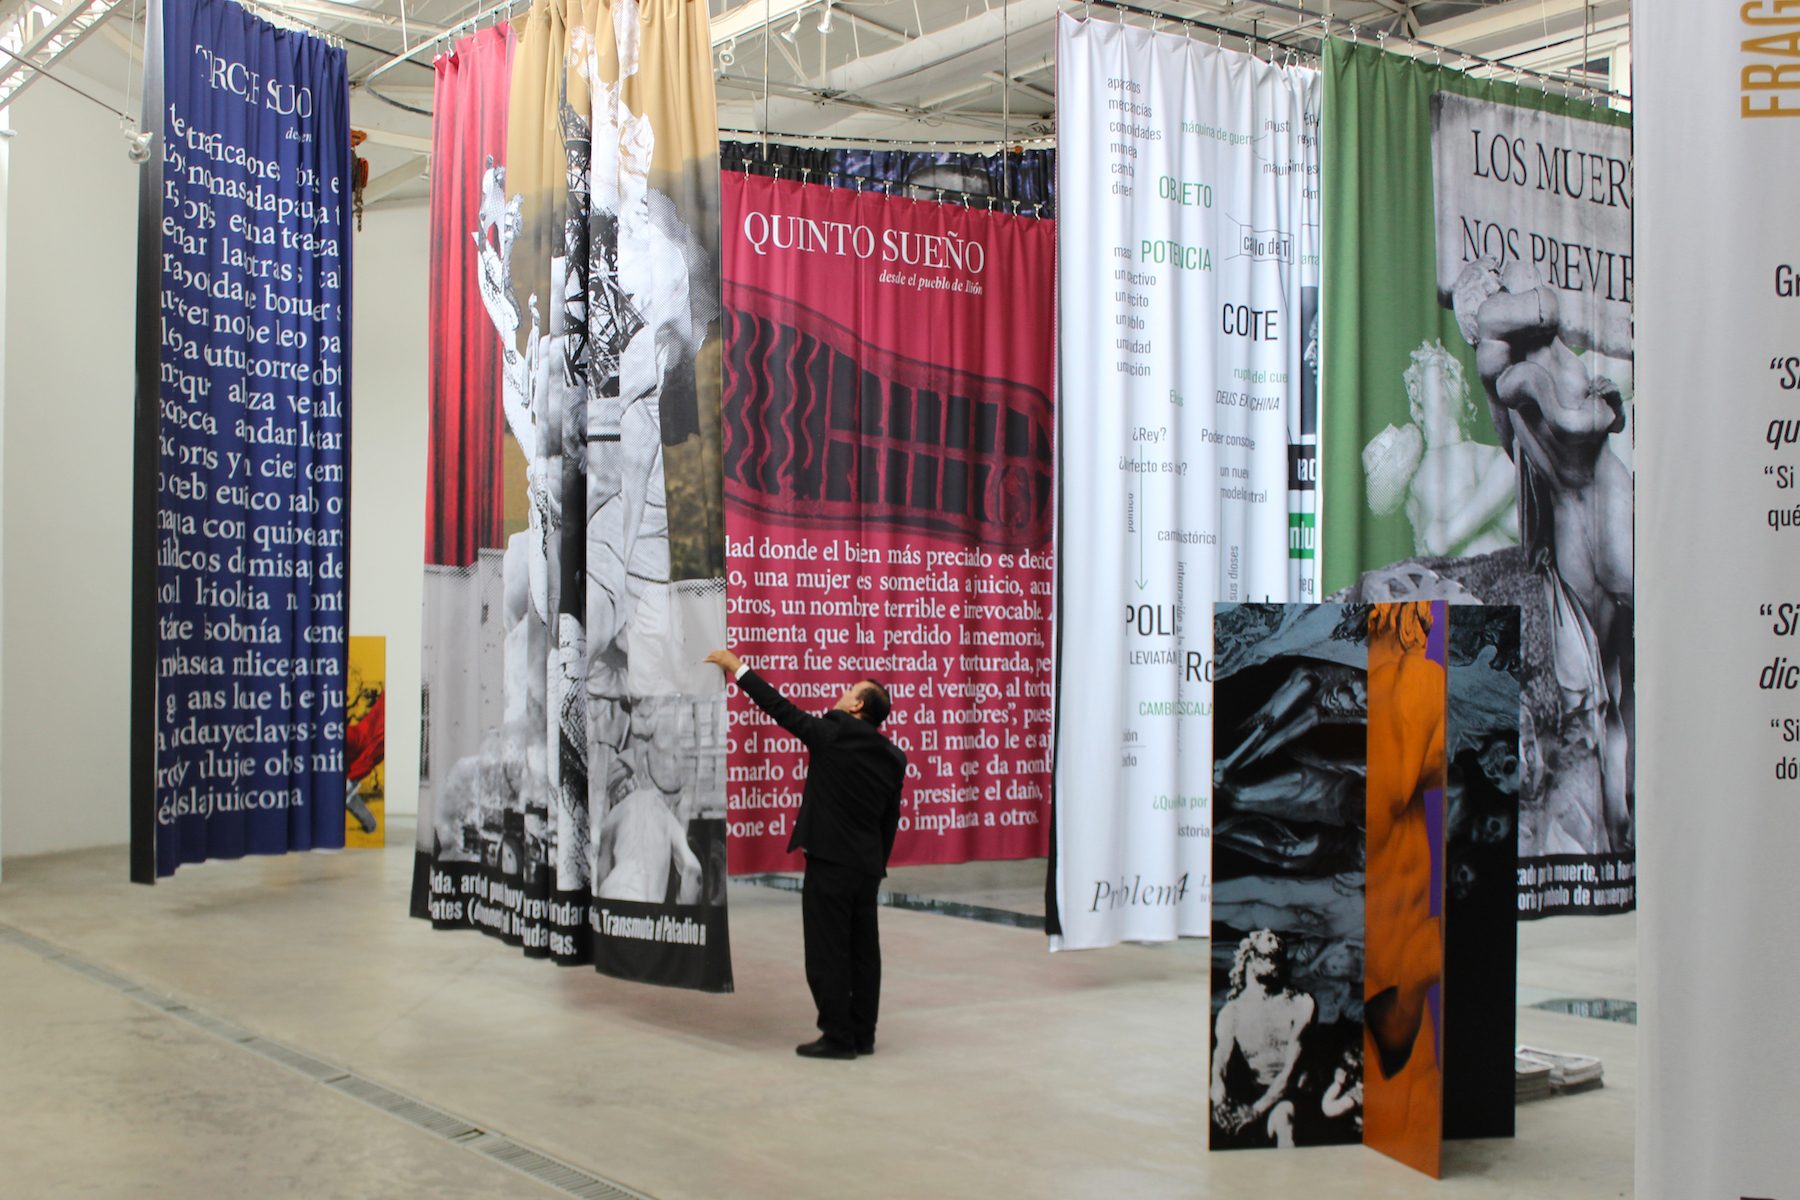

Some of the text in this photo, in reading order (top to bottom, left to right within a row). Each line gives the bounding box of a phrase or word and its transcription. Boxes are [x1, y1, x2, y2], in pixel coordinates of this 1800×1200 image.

[1217, 127, 1227, 141] de
[1471, 130, 1527, 187] LOS
[744, 211, 985, 274] QUINTO SUEÑO
[1460, 216, 1520, 267] NOS
[1141, 240, 1212, 272] POTENCIA
[879, 269, 906, 285] desde
[908, 273, 917, 287] el
[917, 276, 951, 291] pueblo
[951, 278, 963, 292] de
[1251, 370, 1266, 384] del
[1216, 390, 1238, 406] DEUS
[1132, 426, 1167, 444] ¿Rey?
[759, 537, 817, 560] donde
[823, 540, 838, 561] el
[845, 541, 881, 563] bien
[887, 545, 921, 565] más
[926, 547, 992, 571] preciado
[999, 554, 1014, 568] es
[754, 571, 788, 587] una
[796, 569, 851, 595] mujer
[857, 575, 872, 590] es
[880, 571, 959, 592] sometida
[965, 579, 971, 592] a
[973, 575, 1024, 599] juicio,
[727, 595, 1044, 620] otros, un nombre terrible e irrevocable.
[727, 623, 1044, 650] gumenta que ha perdido la memoria,
[739, 654, 798, 671] guerra
[804, 649, 832, 670] fue
[838, 650, 937, 672] secuestrada
[943, 656, 955, 678] y
[960, 651, 1033, 673] torturada,
[919, 677, 933, 697] el
[937, 677, 1002, 703] verdugo,
[1006, 677, 1020, 697] al
[914, 703, 935, 724] da
[745, 732, 757, 753] el
[921, 730, 938, 750] El
[945, 728, 999, 749] mundo
[1005, 728, 1019, 748] le
[1025, 734, 1037, 748] es
[928, 756, 953, 776] “la
[961, 760, 979, 782] que
[986, 754, 1009, 775] da
[914, 783, 979, 810] presiente
[985, 780, 1001, 800] el
[769, 814, 785, 835] el
[915, 809, 979, 835] implanta
[984, 813, 995, 826] a
[1573, 884, 1591, 906] de
